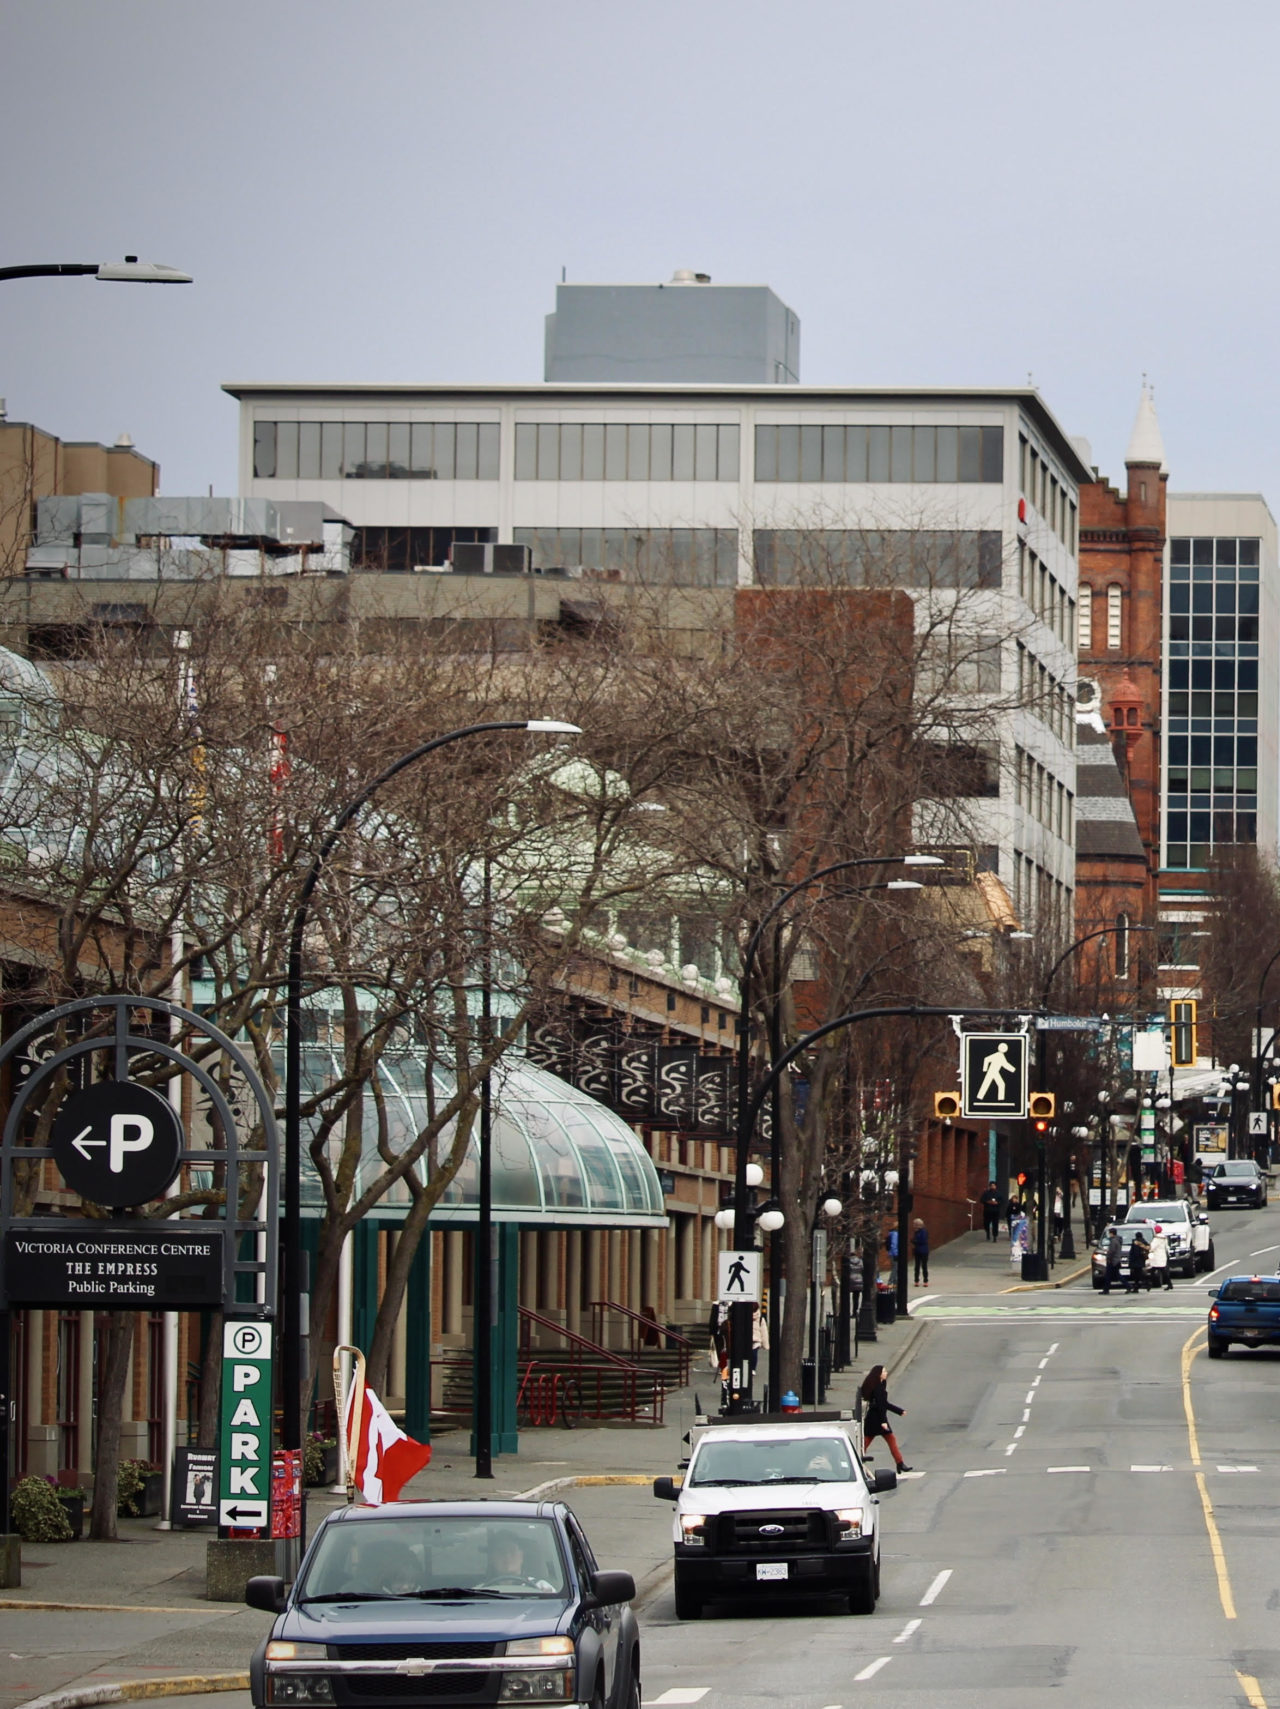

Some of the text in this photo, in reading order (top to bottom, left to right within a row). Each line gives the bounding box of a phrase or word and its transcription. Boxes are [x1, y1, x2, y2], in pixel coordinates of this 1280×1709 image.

[1049, 1019, 1087, 1028] Humboldt
[109, 1114, 154, 1174] P
[16, 1241, 210, 1256] VICTORIA CONFERENCE CENTRE
[66, 1262, 158, 1276] THE EMPRESS
[68, 1281, 155, 1296] Public Parking
[242, 1332, 256, 1349] P
[230, 1364, 261, 1494] PARK
